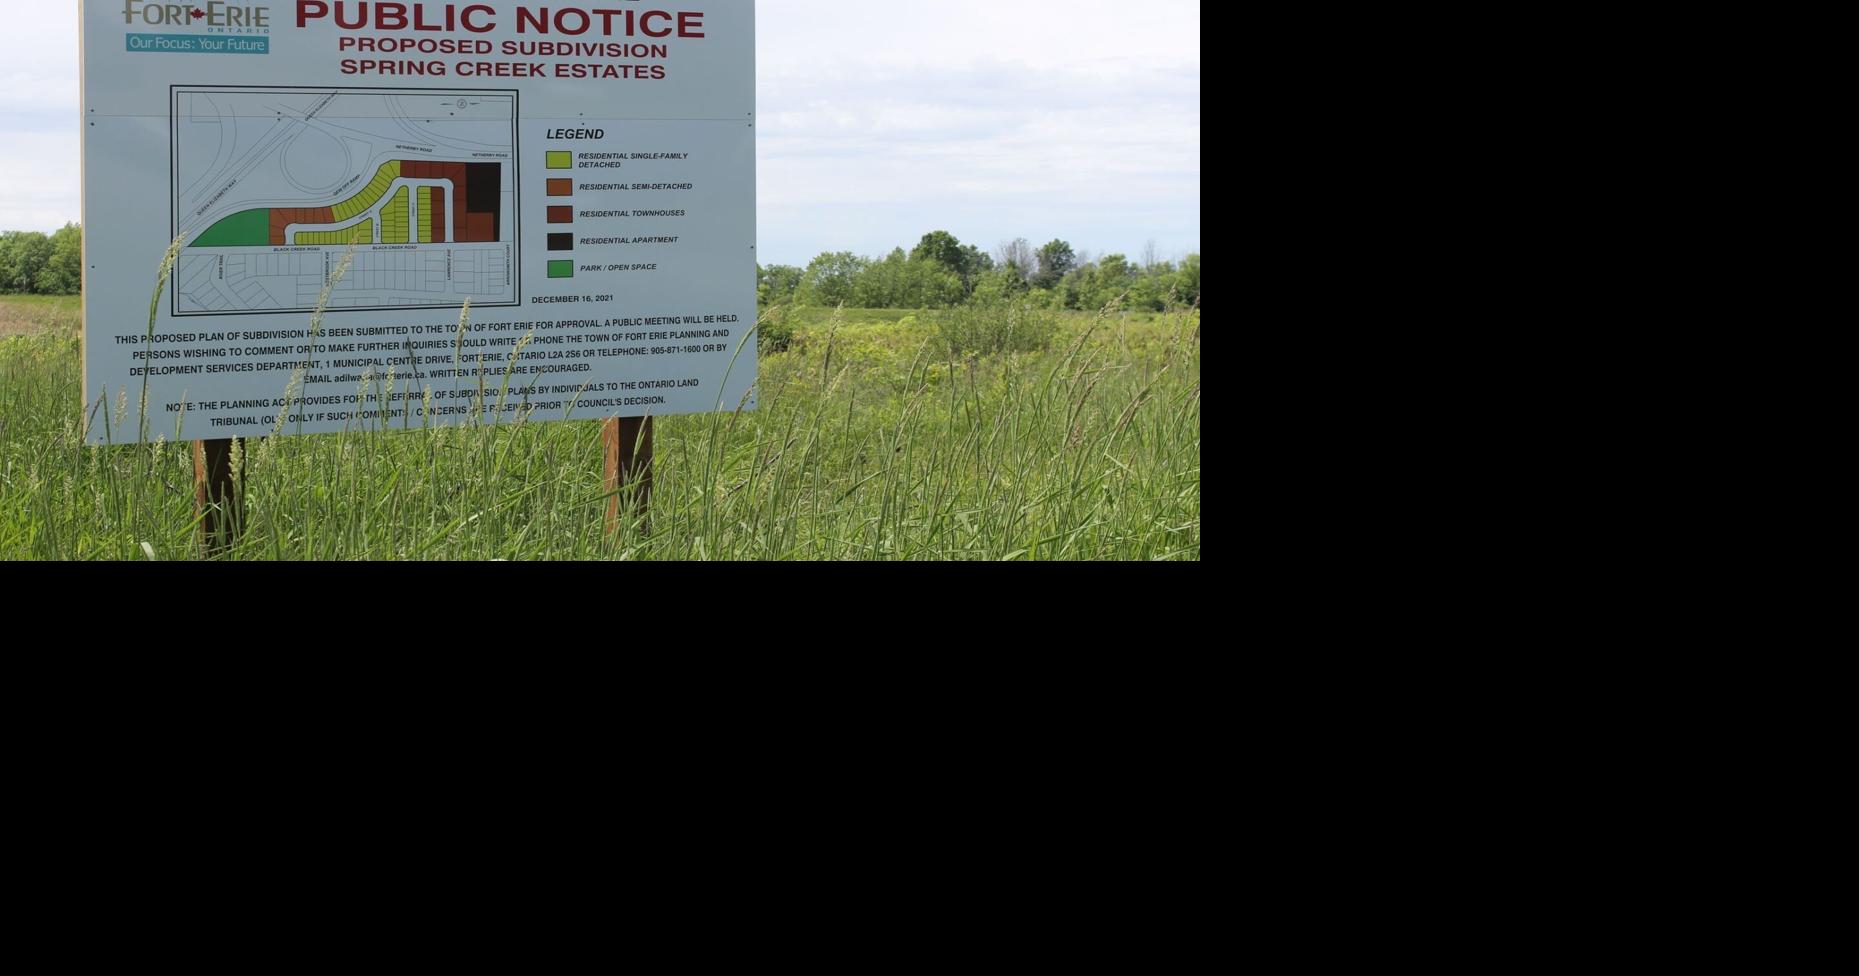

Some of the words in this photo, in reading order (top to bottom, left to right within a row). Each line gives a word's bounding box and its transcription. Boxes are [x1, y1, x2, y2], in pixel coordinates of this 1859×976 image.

[122, 0, 194, 26] FORT
[206, 0, 270, 28] ERIE
[296, 0, 497, 34] PUBLIC
[516, 6, 706, 38] NOTICE
[130, 36, 152, 48] Our
[156, 38, 195, 49] Focus:
[199, 38, 224, 50] Your
[228, 39, 265, 50] Future
[339, 36, 492, 54] PROPOSED
[502, 40, 667, 58] SUBDIVISION
[340, 59, 446, 76] SPRING
[455, 61, 547, 78] CREEK
[555, 63, 665, 80] ESTATES
[546, 129, 604, 140] LEGEND
[630, 152, 688, 160] SINGLE-FAMILY
[531, 296, 579, 304] DECEMBER
[582, 295, 593, 304] 16,
[115, 335, 138, 344] THIS
[141, 333, 196, 343] PROPOSED
[199, 332, 224, 342] PLAN
[227, 332, 240, 340] OF
[243, 330, 304, 339] SUBDIVISION
[328, 328, 354, 337] BEEN
[356, 327, 408, 336] SUBMITTED
[410, 326, 423, 334] TO
[425, 325, 442, 333] THE
[445, 324, 471, 332] TON
[474, 323, 486, 332] OF
[488, 323, 511, 331] FORT
[514, 322, 533, 330] ERIE
[556, 320, 602, 329] APPROVAL.
[605, 319, 610, 327] A
[612, 318, 642, 327] PUBLIC
[645, 316, 681, 325] MEETING
[683, 316, 702, 324] WILL
[704, 315, 714, 323] BE
[716, 314, 739, 322] HELD.
[133, 350, 180, 359] PERSONS
[183, 349, 226, 358] WISHING
[229, 348, 242, 356] TO
[245, 346, 294, 355] COMMENT
[297, 345, 310, 353] OR
[313, 344, 325, 353] TO
[328, 344, 355, 352] MAKE
[357, 342, 400, 351] FURTHER
[402, 340, 448, 350] INQUIRIES
[450, 339, 487, 348] SOULD
[489, 338, 516, 346] WRITE
[534, 336, 564, 344] PHONE
[566, 335, 582, 343] THE
[584, 334, 609, 342] TOWN
[612, 333, 623, 341] OF
[625, 332, 646, 341] FORT
[649, 331, 667, 340] ERIE
[670, 330, 710, 339] PLANNING
[713, 329, 729, 337] AND
[130, 365, 203, 376] DEVELOPMENT
[206, 363, 253, 373] SERVICES
[256, 361, 323, 371] DEPARTMENT,
[333, 358, 384, 367] MUNICIPAL
[386, 356, 422, 366] CENTRE
[425, 355, 454, 364] DRIVE,
[483, 353, 504, 362] ERIE,
[507, 352, 545, 360] OTARIO
[548, 351, 563, 359] L2A
[566, 350, 580, 358] 2S6
[583, 349, 595, 358] OR
[598, 347, 649, 356] TELEPHONE:
[651, 345, 701, 354] 905-871-1600
[703, 344, 714, 352] OR
[716, 343, 727, 351] BY
[430, 369, 468, 378] WRITTEN
[530, 363, 591, 374] ENCOURAGED.
[166, 403, 196, 411] NOE:
[198, 402, 217, 410] THE
[220, 399, 269, 409] PLANNING
[294, 396, 340, 406] PROVIDES
[365, 394, 383, 402] THE
[386, 392, 432, 401] EFRR
[435, 391, 446, 399] OF
[449, 388, 502, 398] SUBDISIO
[508, 387, 536, 395] PLANS
[552, 383, 604, 393] INDIVIDUALS
[606, 382, 617, 391] TO
[620, 381, 636, 390] THE
[638, 380, 675, 389] ONTARIO
[677, 379, 699, 388] LAND
[210, 416, 258, 426] TRIBUNAL
[261, 414, 284, 425] (OL
[289, 414, 313, 422] ONLY
[317, 413, 325, 421] IF
[330, 412, 353, 421] SUCH
[356, 409, 408, 419] COMENTS
[411, 408, 414, 416] /
[416, 406, 466, 416] CNCERNS
[490, 402, 532, 412] RCEIVD
[534, 401, 561, 410] PRIOR
[578, 398, 622, 408] COUNCIL'S
[624, 396, 666, 406] DECISION.
